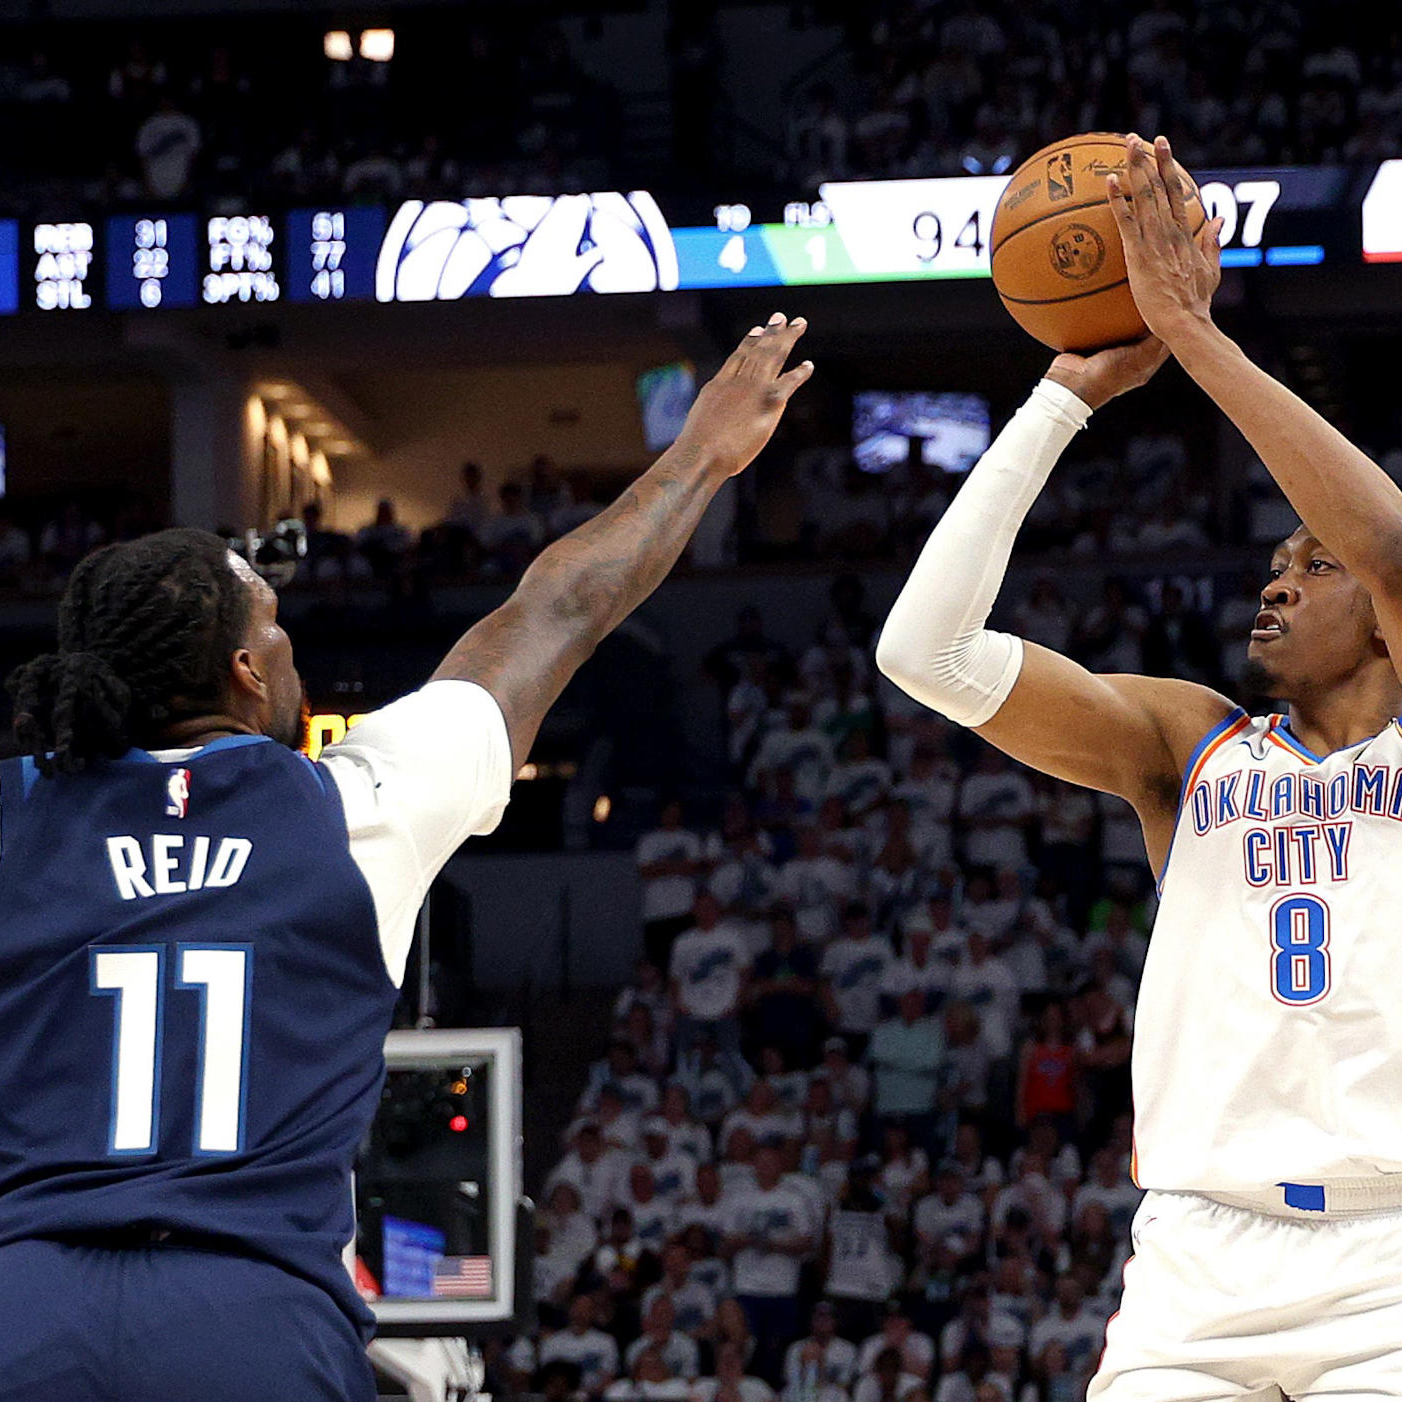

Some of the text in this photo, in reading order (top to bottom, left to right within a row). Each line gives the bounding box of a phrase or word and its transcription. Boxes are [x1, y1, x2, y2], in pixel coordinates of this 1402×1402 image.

[310, 241, 346, 271] 77
[718, 235, 747, 273] 4
[804, 234, 827, 271] 1
[913, 210, 984, 263] 94
[310, 269, 344, 299] 41
[106, 834, 253, 900] REID
[1243, 821, 1352, 887] CITY
[1269, 892, 1330, 1006] 8
[89, 941, 254, 1156] 11
